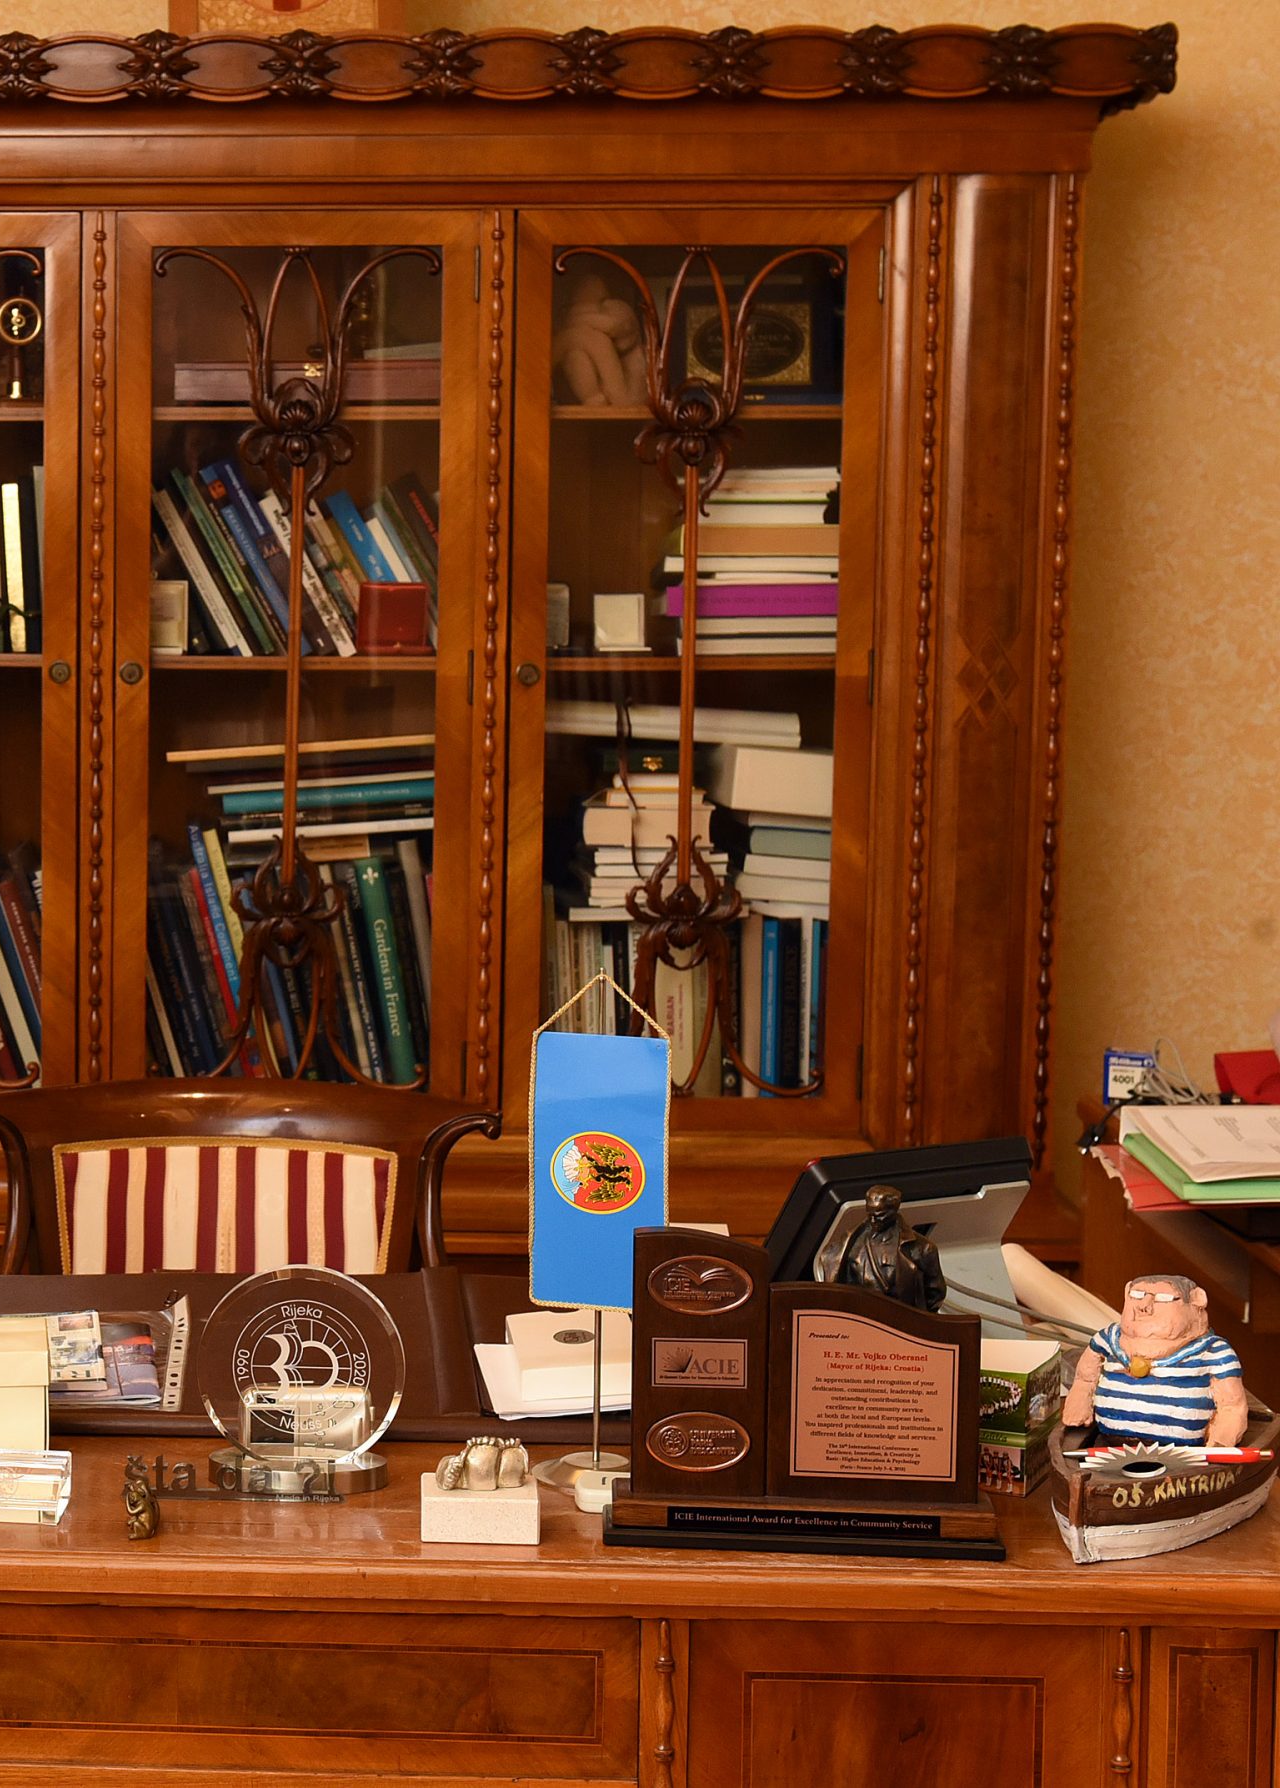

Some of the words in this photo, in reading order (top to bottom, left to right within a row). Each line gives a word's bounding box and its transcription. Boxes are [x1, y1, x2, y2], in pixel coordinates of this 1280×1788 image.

[186, 823, 211, 880] Australia
[202, 882, 222, 920] Island
[213, 921, 240, 983] Continent
[372, 918, 395, 974] Gardens
[382, 975, 398, 991] in
[385, 992, 407, 1038] France
[1112, 1075, 1135, 1084] 4001
[280, 1304, 323, 1321] Rijeka
[863, 1352, 887, 1362] Vojko
[889, 1353, 928, 1362] Obersnel
[236, 1349, 250, 1380] 1990
[353, 1352, 366, 1387] 2020
[689, 1358, 739, 1374] ACIE
[826, 1362, 853, 1371] (Mayor
[893, 1365, 925, 1373] Croatia)
[823, 1377, 862, 1386] appreciation
[877, 1379, 911, 1387] recognition
[831, 1395, 868, 1404] outstanding
[869, 1396, 911, 1404] contributions
[865, 1405, 900, 1414] community
[881, 1415, 912, 1423] European
[817, 1421, 843, 1430] inspired
[844, 1422, 886, 1431] professionals
[864, 1432, 896, 1440] knowledge
[276, 1493, 300, 1502] Made
[303, 1494, 311, 1502] in
[312, 1494, 340, 1504] Rijeka
[1112, 1481, 1145, 1508] OŠ
[674, 1512, 695, 1521] ICIE
[696, 1513, 750, 1524] International
[751, 1515, 779, 1524] Award
[780, 1515, 793, 1525] for
[794, 1516, 838, 1527] Excellence
[840, 1518, 849, 1527] in
[850, 1518, 900, 1531] Community
[902, 1521, 933, 1530] Service
